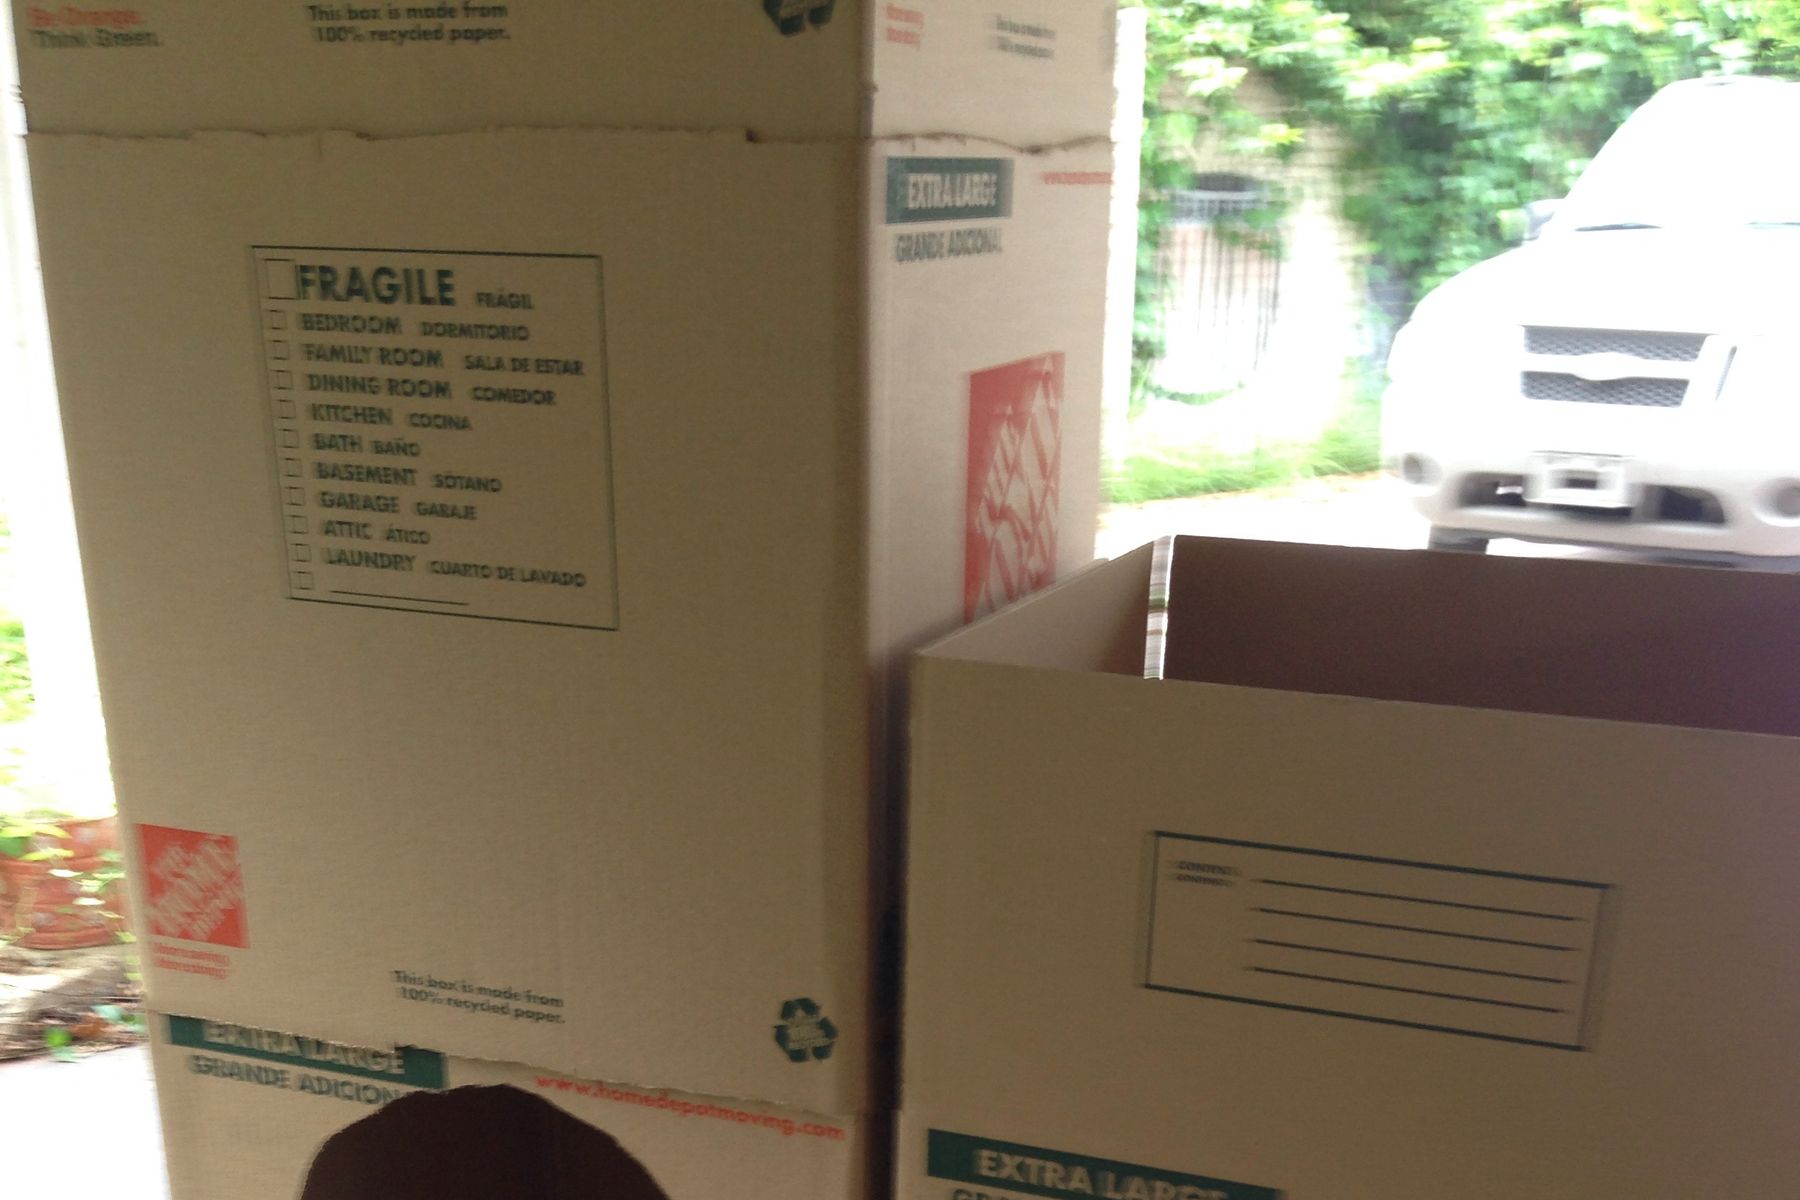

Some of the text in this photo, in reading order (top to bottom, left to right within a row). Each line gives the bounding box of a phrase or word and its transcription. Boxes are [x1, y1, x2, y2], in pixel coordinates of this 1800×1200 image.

[387, 2, 401, 20] is
[405, 2, 457, 19] made
[462, 2, 508, 18] from
[370, 23, 444, 46] recycled
[907, 172, 953, 209] EXTRA
[295, 264, 457, 306] FRAGILE
[301, 312, 530, 341] BEDROOM DORMITORIO
[303, 343, 584, 376] FAMILY ROOM SALA DE ESTAR
[306, 373, 556, 405] DINING ROOM COMEDOR
[311, 403, 472, 431] KITCHEN COCINA
[313, 432, 362, 452] BATH
[315, 461, 417, 486] BASEMENT
[318, 490, 477, 521] GARAGE GARAJE
[323, 519, 371, 541] ATTIC
[325, 548, 587, 588] LAUNDRY CUARTO DE LAVADO
[391, 970, 565, 1008] This box is made from
[399, 985, 443, 1005] 100%
[447, 997, 512, 1016] recycled
[189, 1054, 291, 1089] GRANDE
[976, 1149, 1094, 1195] EXTRA
